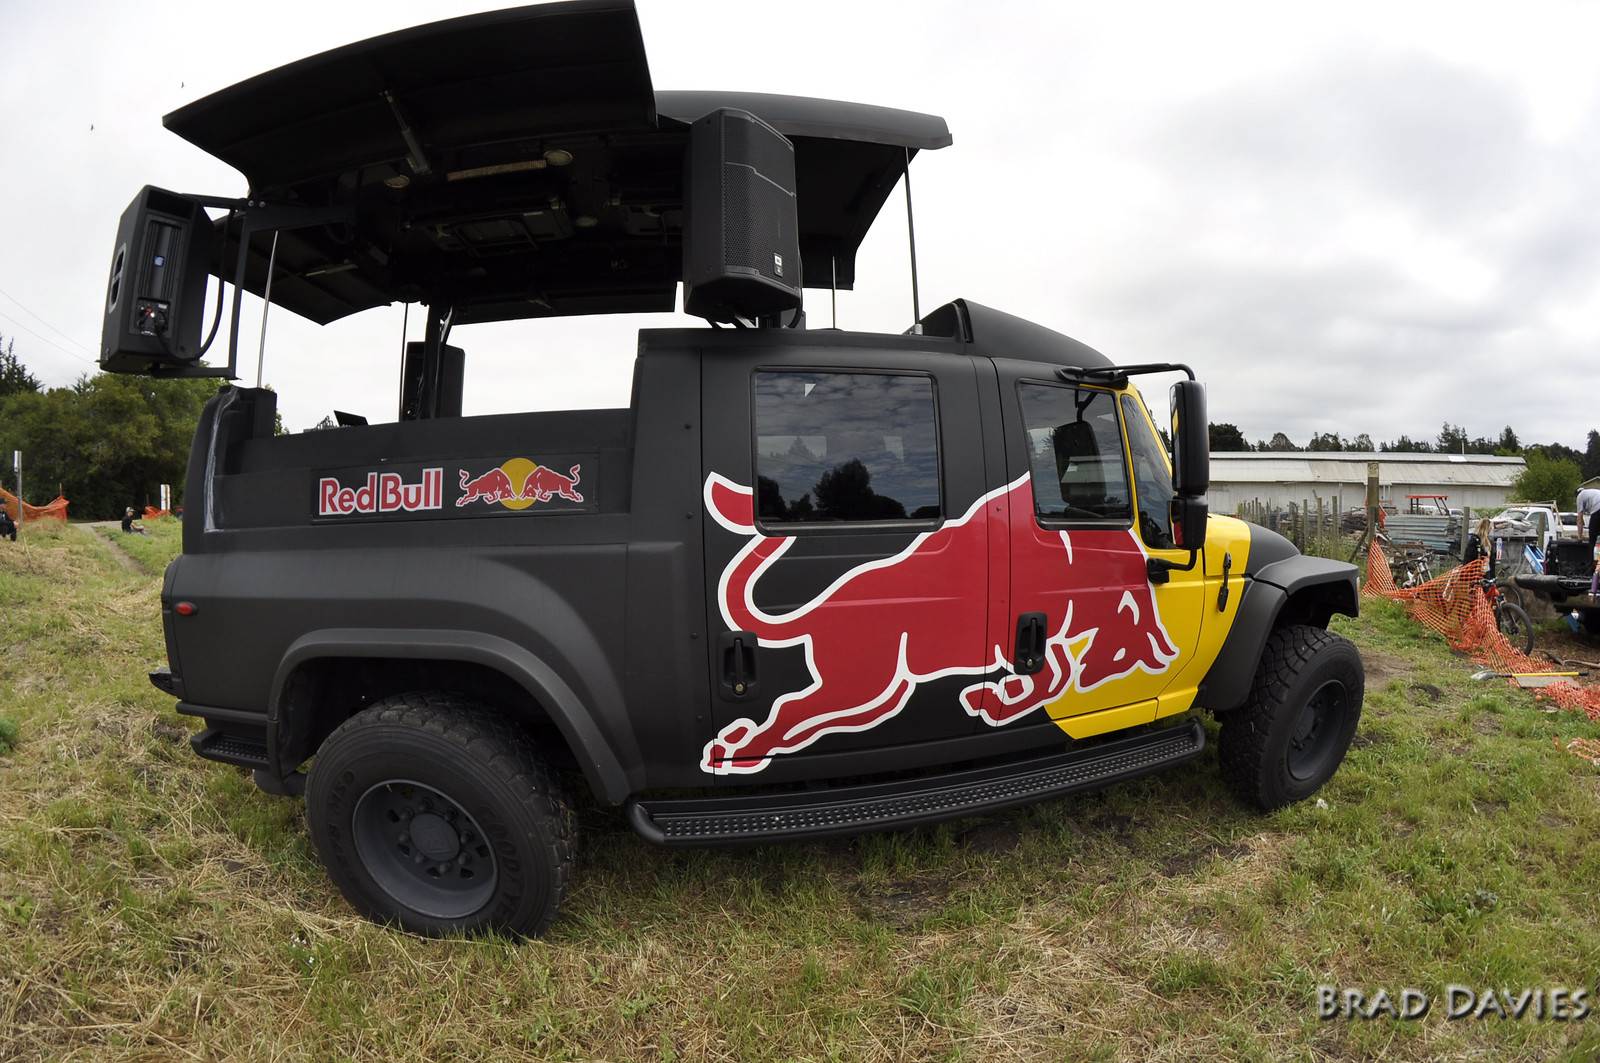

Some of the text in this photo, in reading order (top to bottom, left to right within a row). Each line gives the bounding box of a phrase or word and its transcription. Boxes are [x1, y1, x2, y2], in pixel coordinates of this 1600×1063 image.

[320, 467, 443, 515] Red Bull
[474, 801, 522, 922] GOODYE
